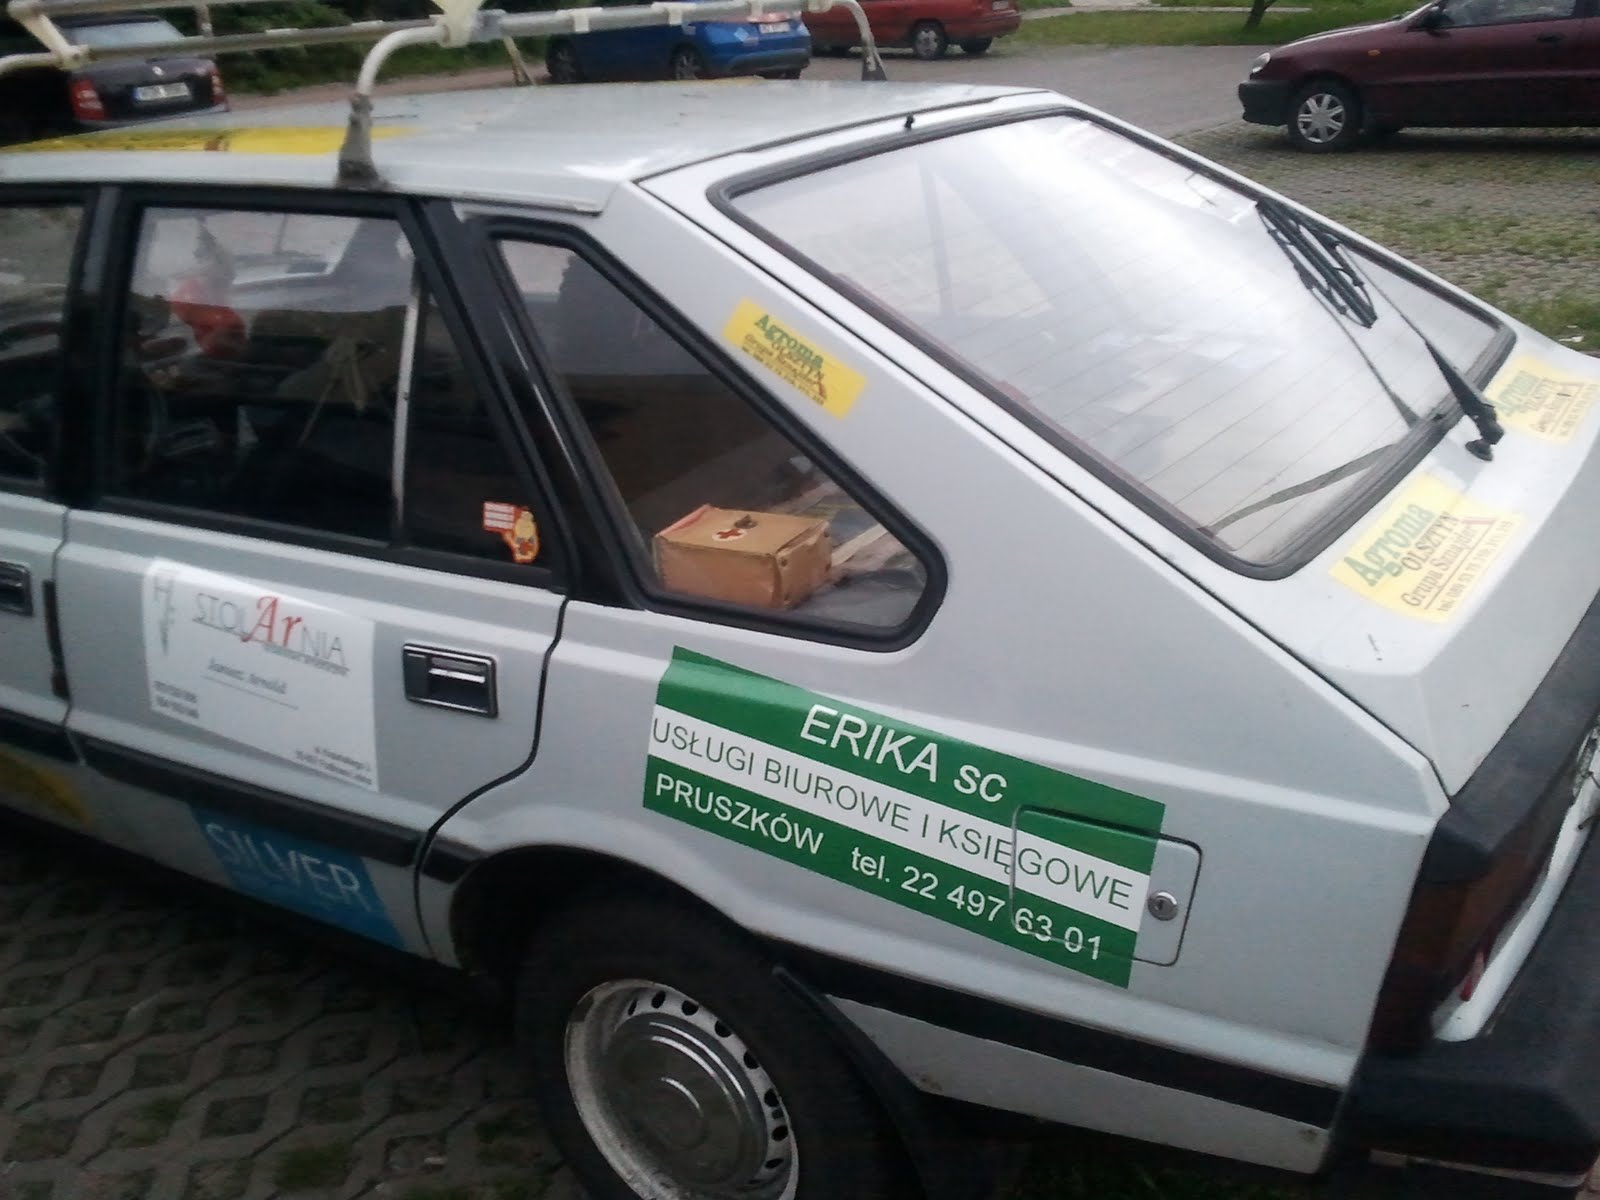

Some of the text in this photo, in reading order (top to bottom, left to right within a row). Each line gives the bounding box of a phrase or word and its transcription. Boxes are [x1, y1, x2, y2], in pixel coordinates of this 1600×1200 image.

[1344, 504, 1436, 587] Agroma
[1401, 511, 1460, 571] OLSZTYN
[1401, 569, 1444, 607] Grupa
[800, 703, 938, 783] ERIKA
[652, 717, 1134, 911] USŁUGI BIUROWE I KSIĘGOWE
[205, 822, 373, 913] SILVER
[655, 773, 1102, 961] PRUSZKÓW tel. 22 497 63 01
